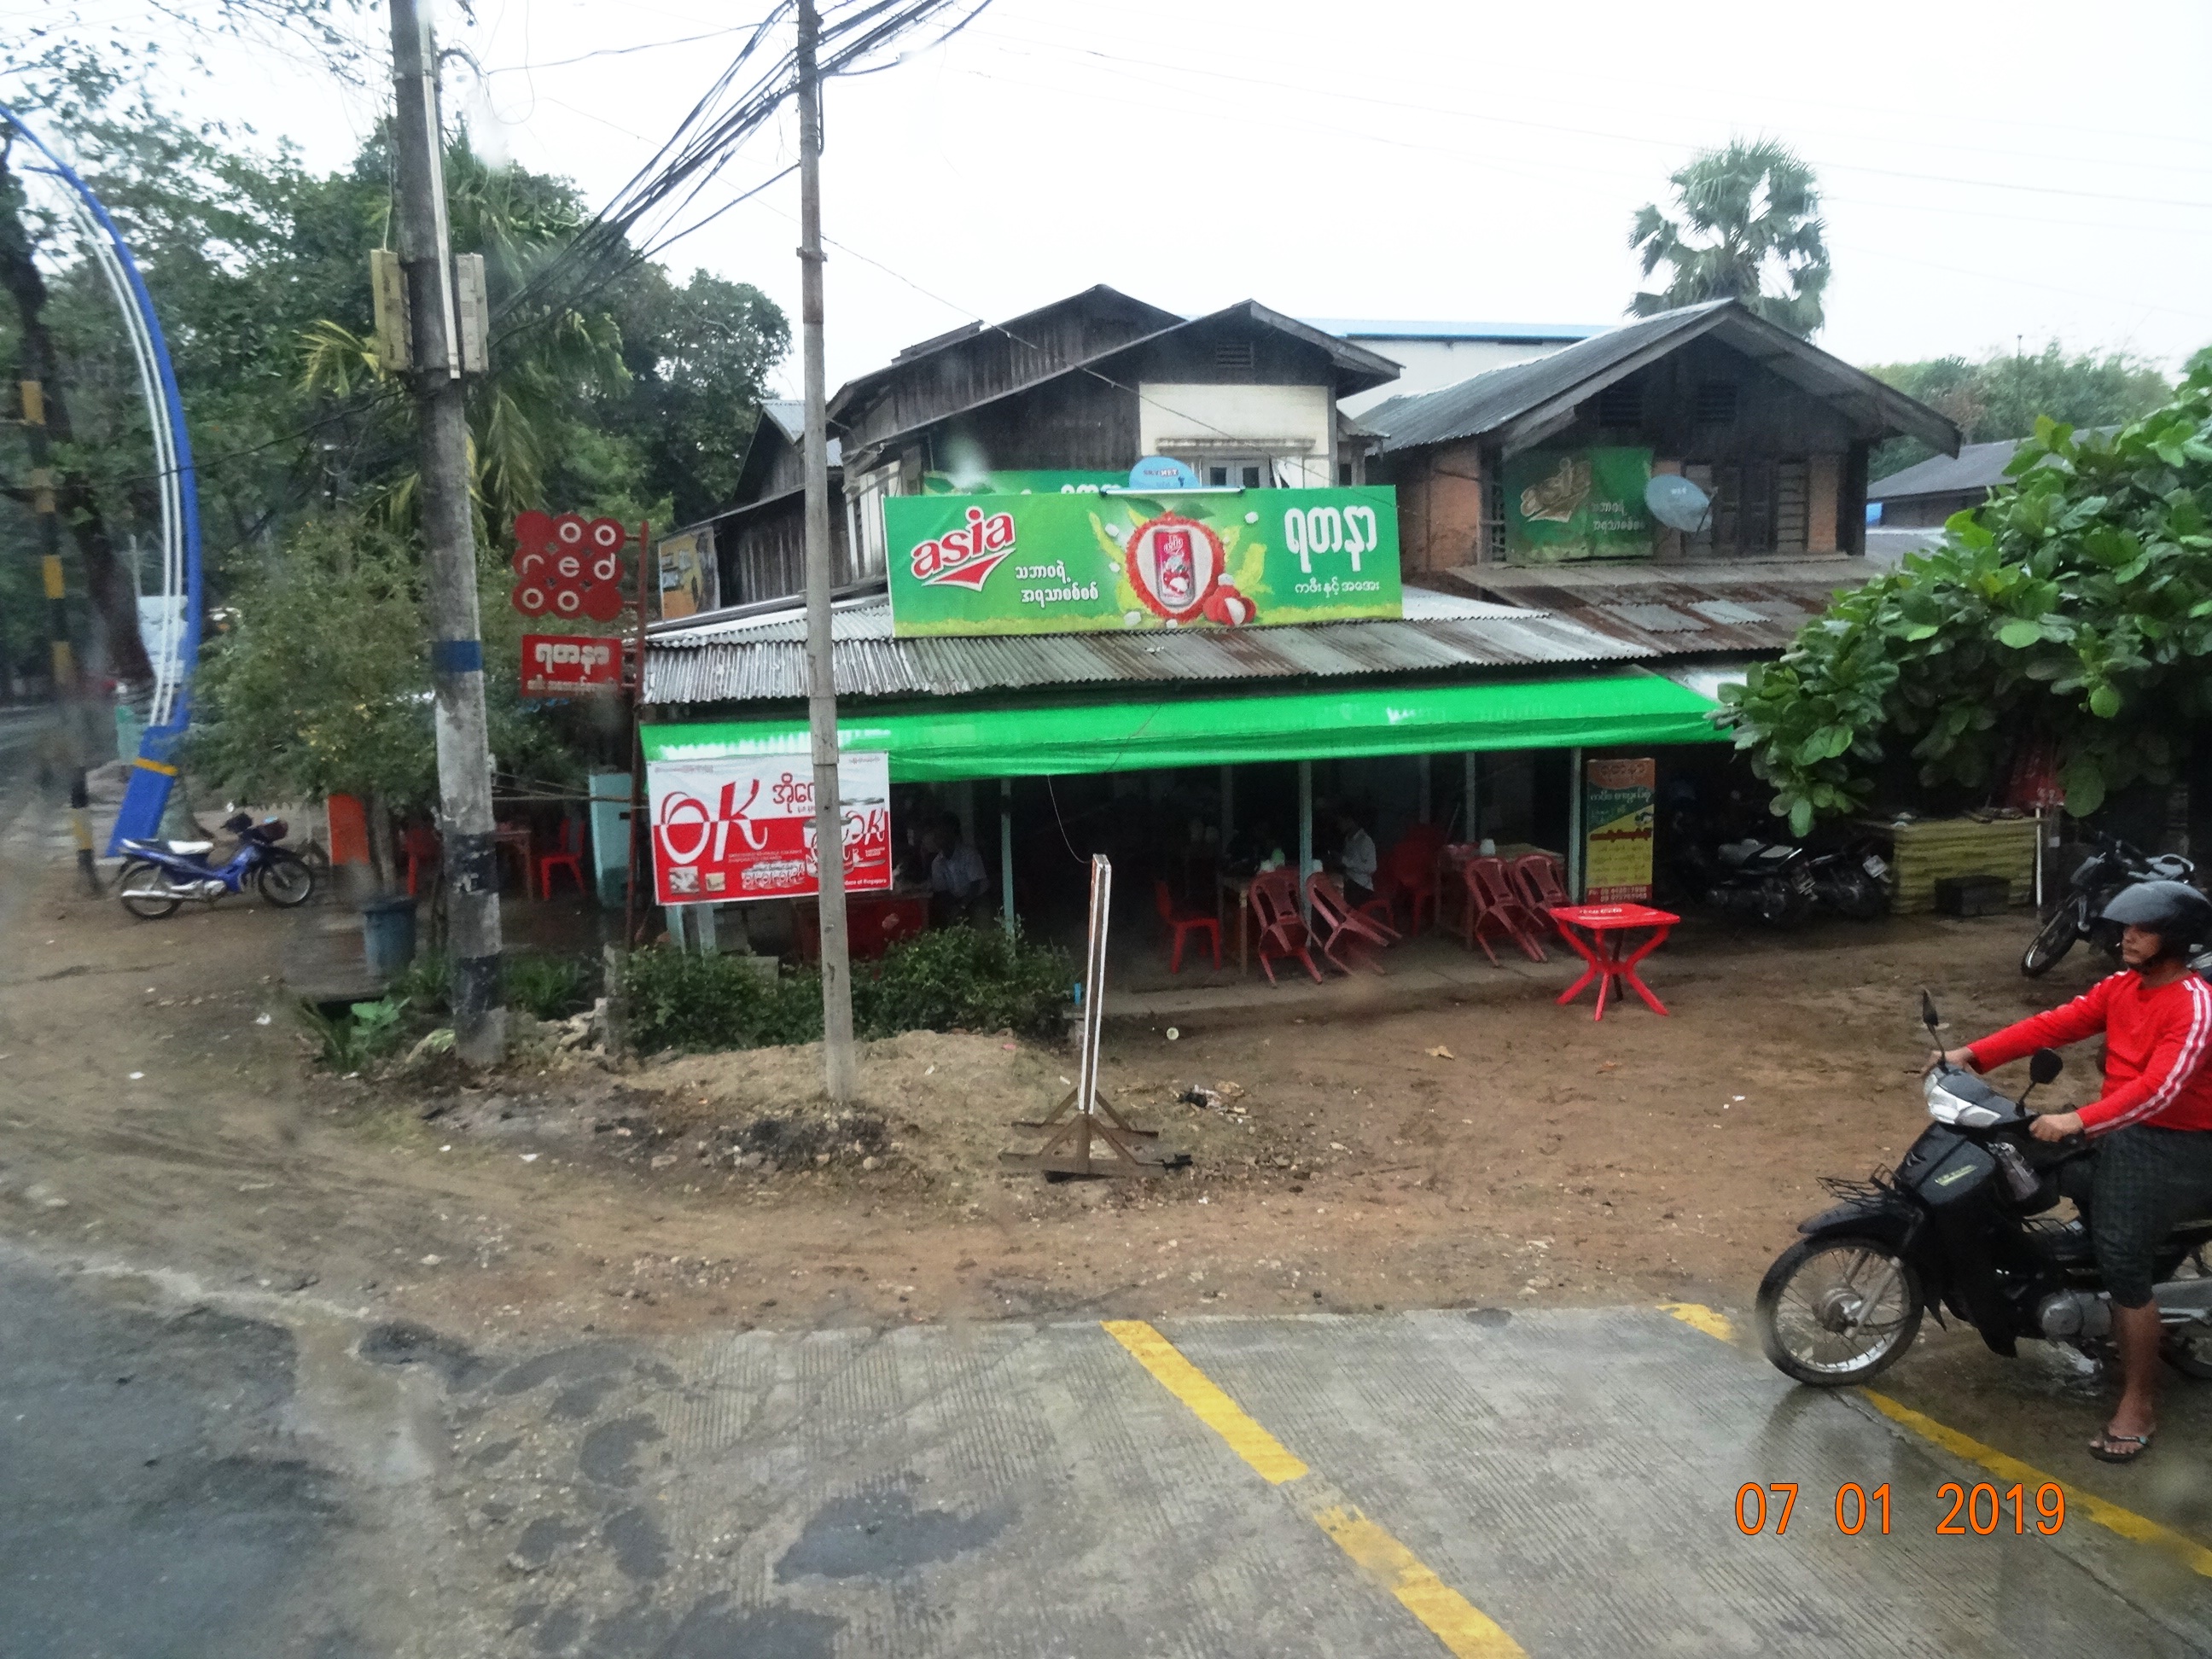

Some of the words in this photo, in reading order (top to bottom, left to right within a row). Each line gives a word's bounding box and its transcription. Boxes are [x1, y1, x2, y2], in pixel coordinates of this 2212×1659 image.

[911, 506, 1016, 579] asia
[1284, 505, 1378, 573] ရတနာ
[660, 778, 768, 864] OK
